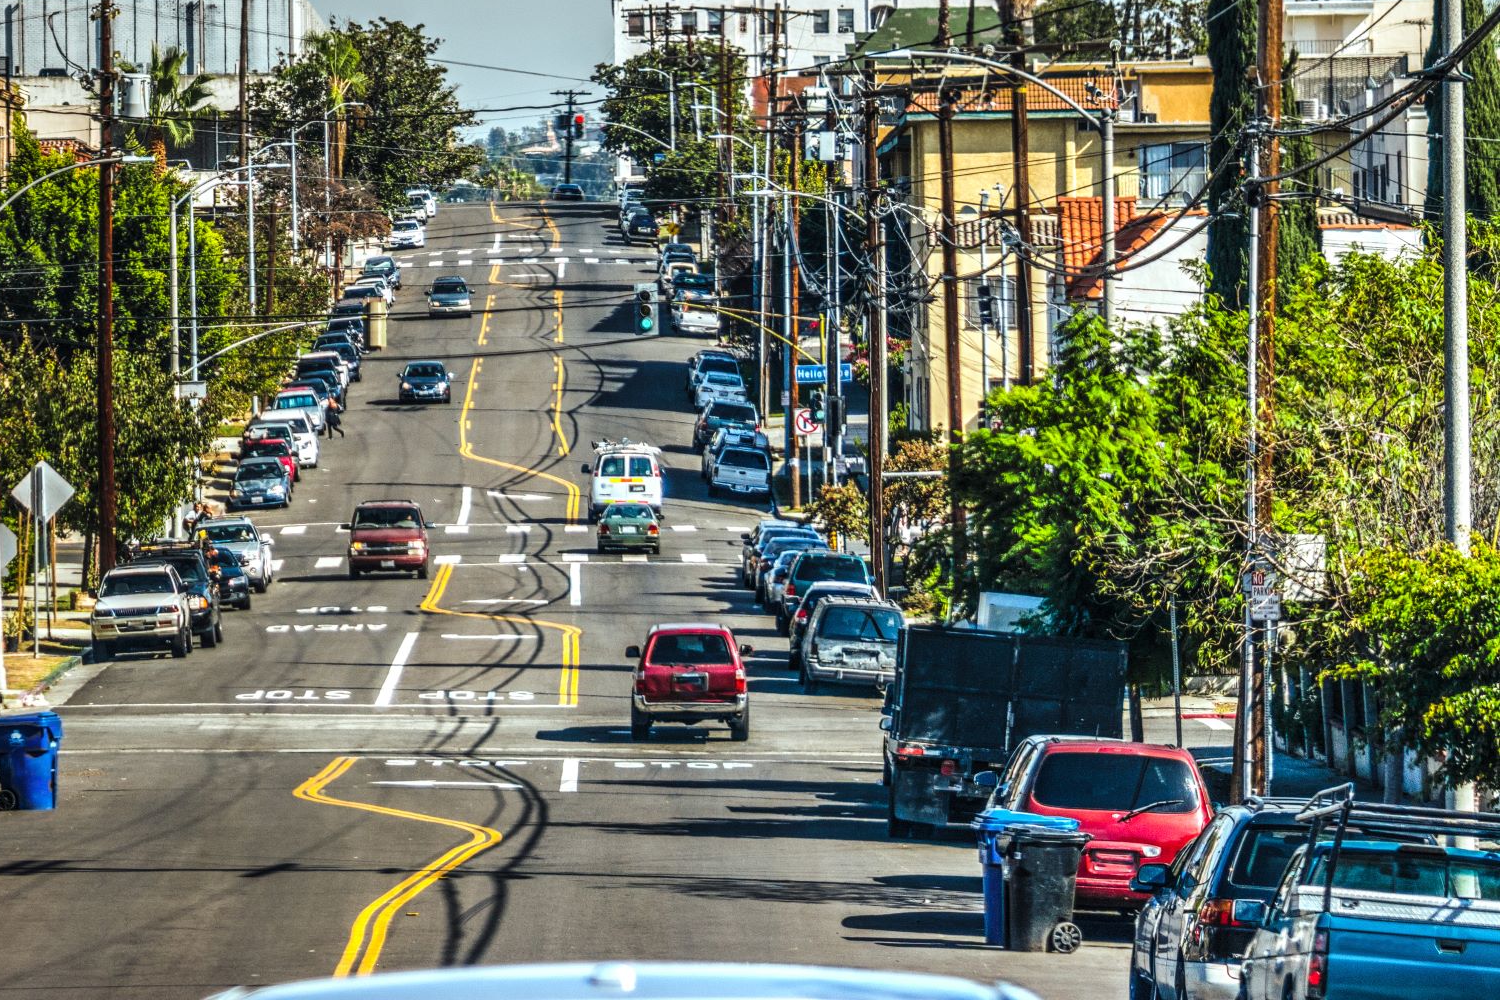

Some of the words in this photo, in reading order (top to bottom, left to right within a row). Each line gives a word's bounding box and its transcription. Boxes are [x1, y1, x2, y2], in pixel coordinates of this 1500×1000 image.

[1252, 572, 1263, 585] NO
[265, 623, 388, 633] AHEAD
[235, 690, 352, 700] STOP
[418, 690, 535, 701] STOP
[385, 759, 529, 767] STOP
[614, 761, 754, 769] STOP
